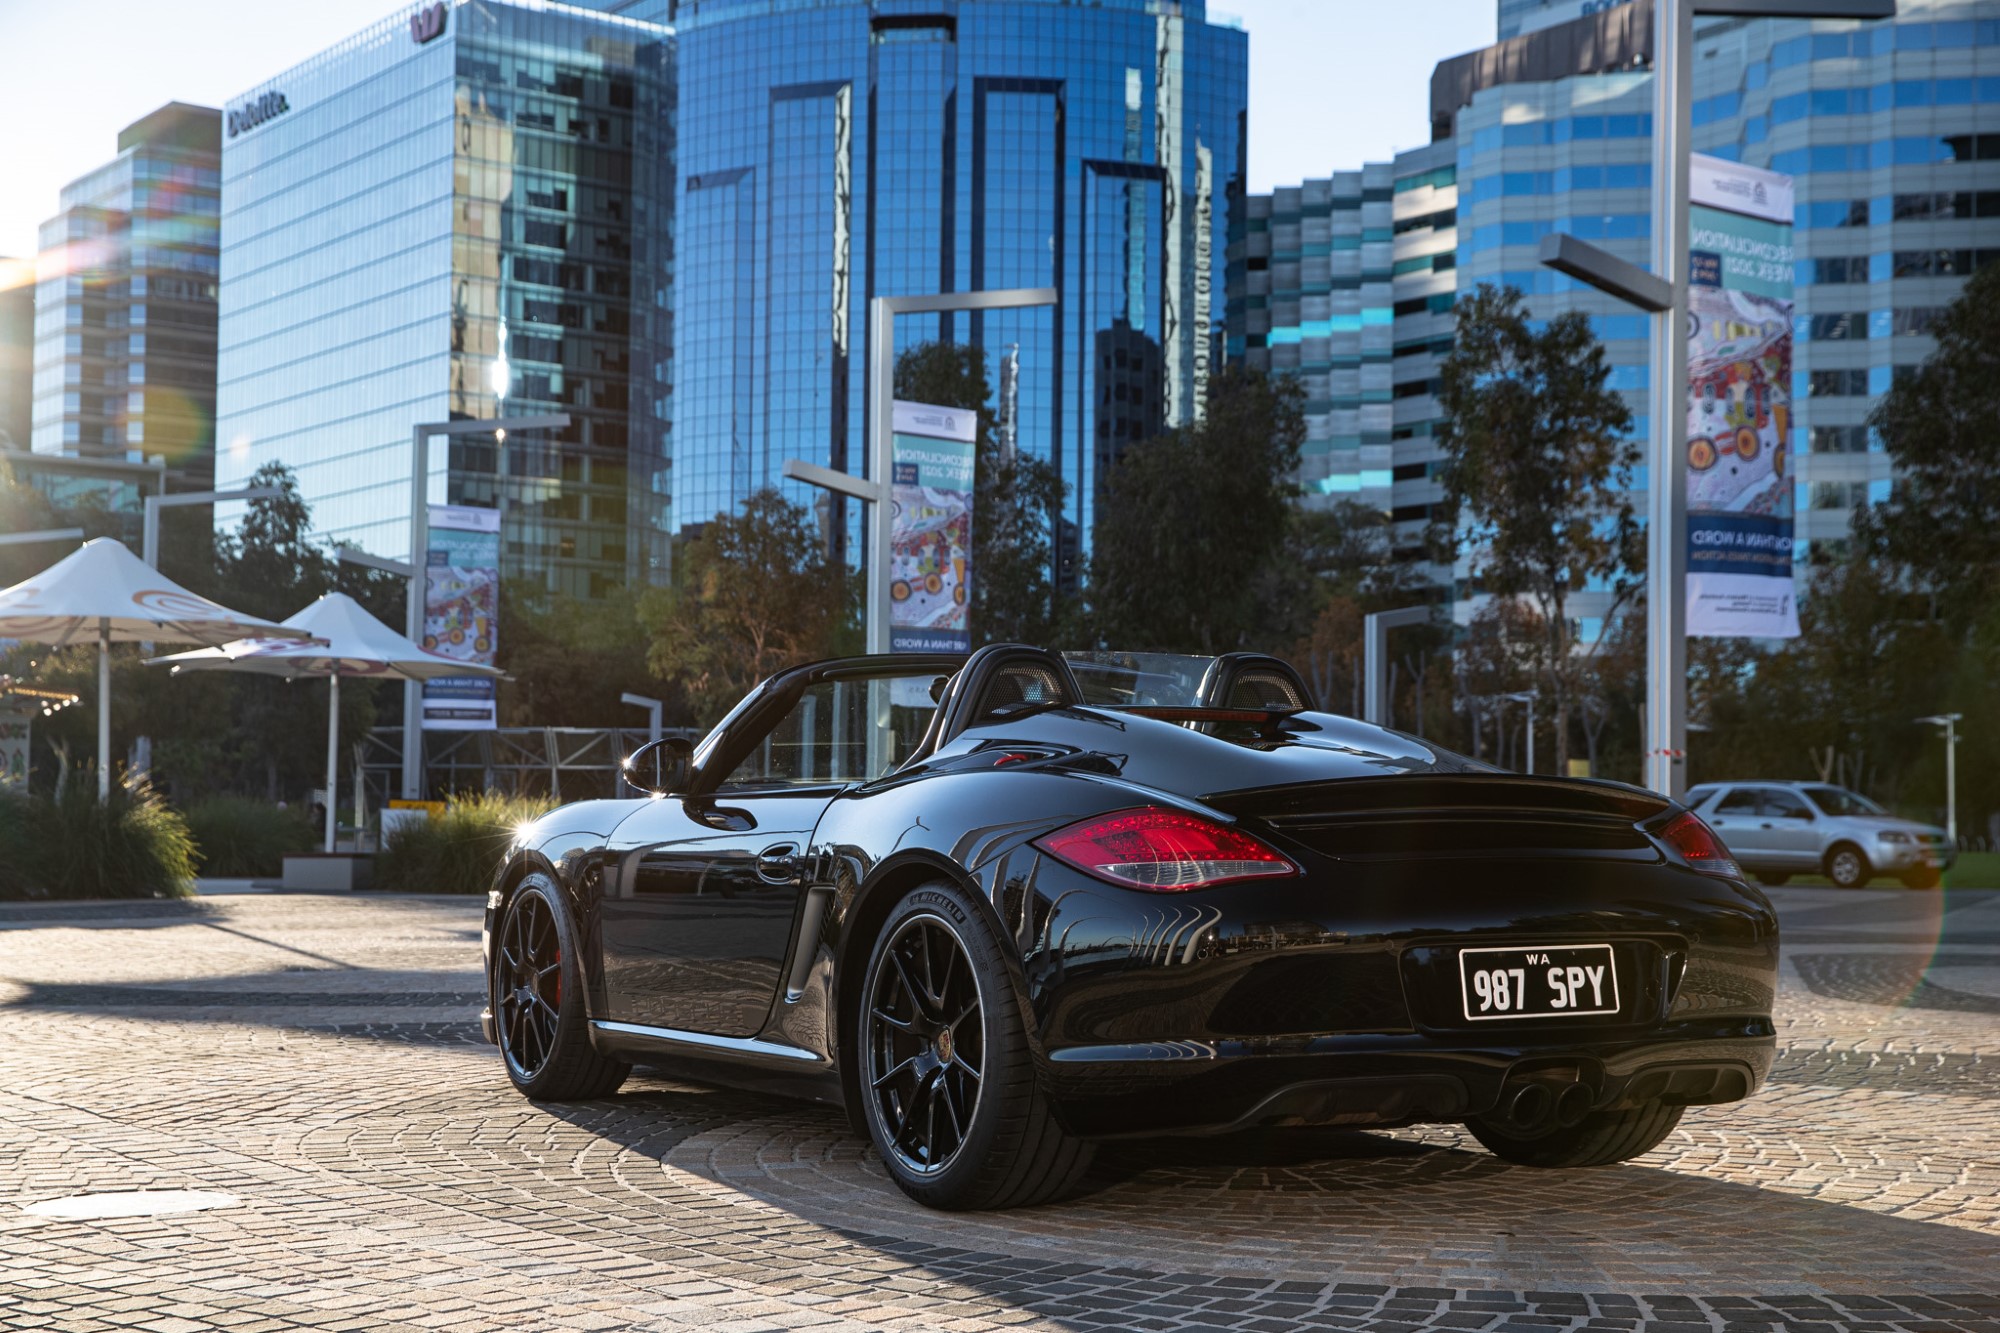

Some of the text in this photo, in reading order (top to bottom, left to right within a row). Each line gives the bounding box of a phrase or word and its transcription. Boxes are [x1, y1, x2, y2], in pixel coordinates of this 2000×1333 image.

[920, 892, 965, 921] MICHELIN
[1526, 953, 1550, 965] WA
[1474, 965, 1605, 1012] 987 SPY
